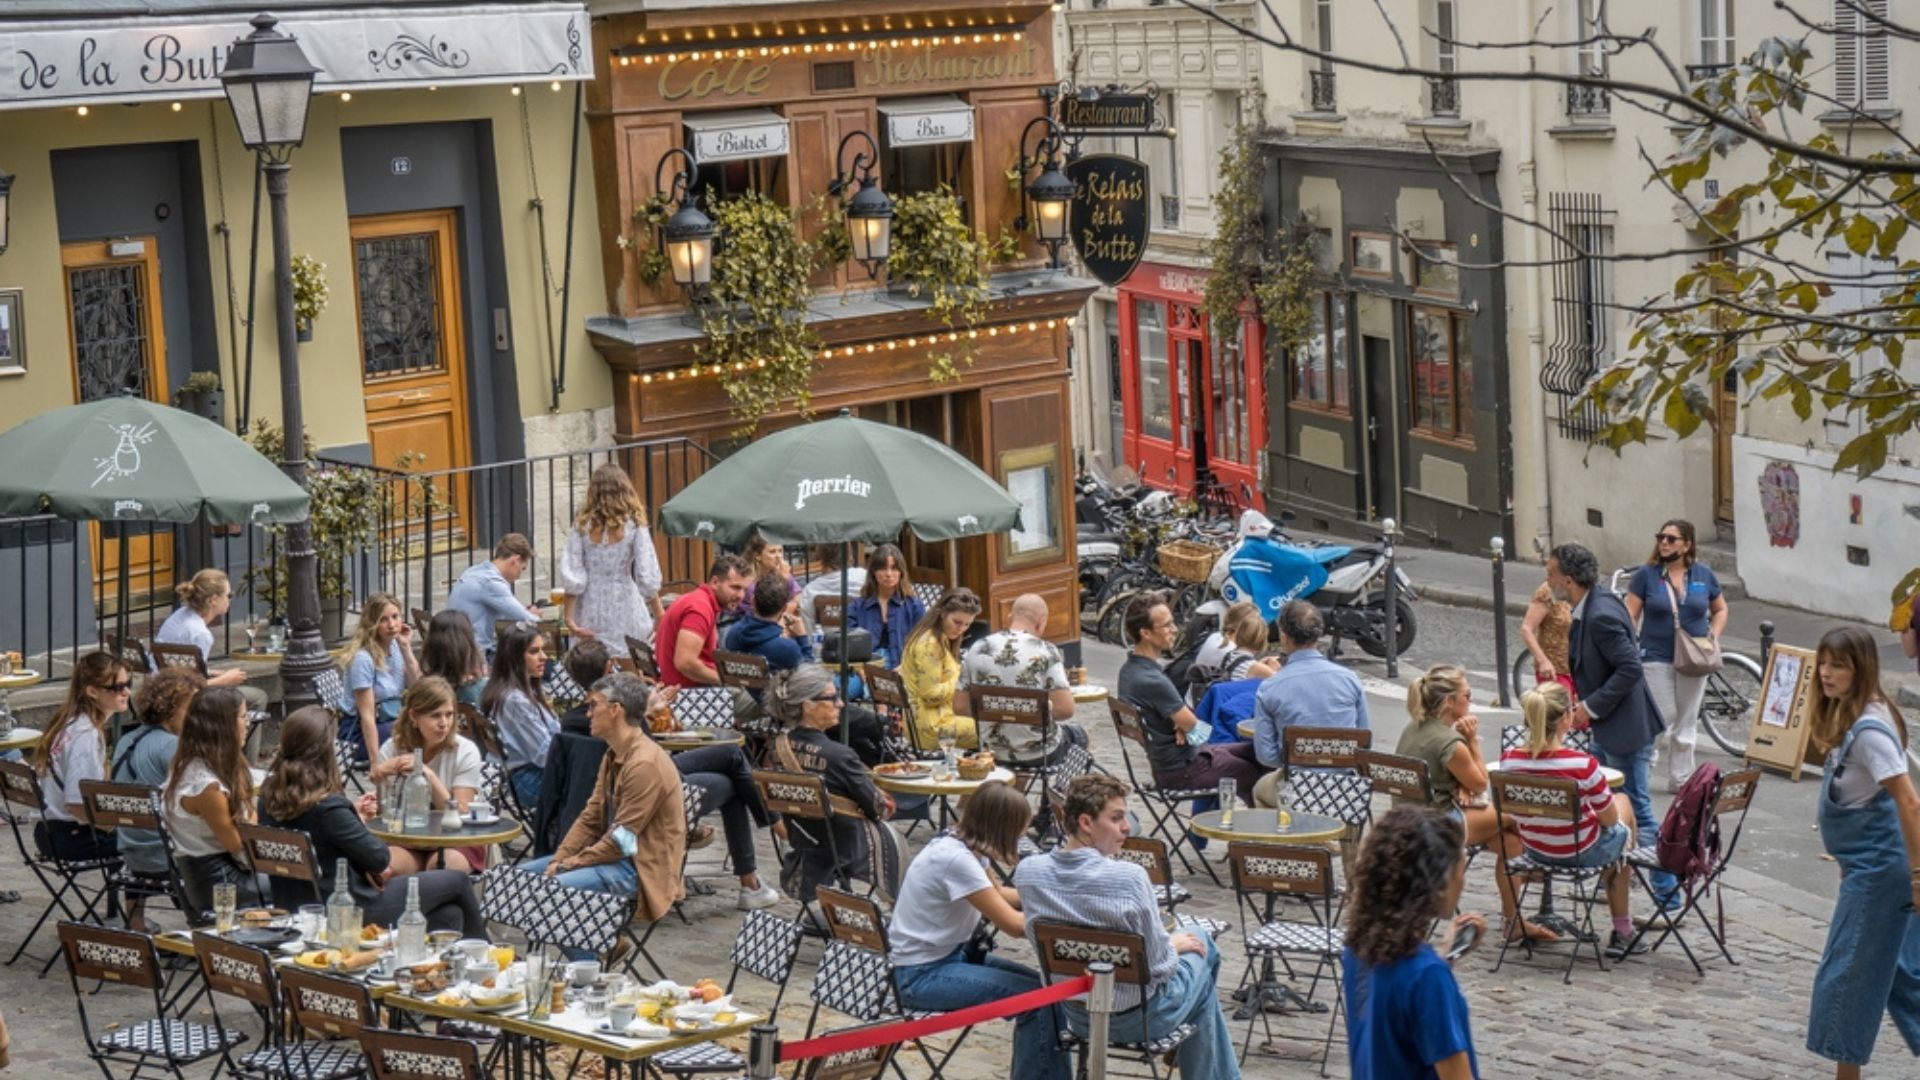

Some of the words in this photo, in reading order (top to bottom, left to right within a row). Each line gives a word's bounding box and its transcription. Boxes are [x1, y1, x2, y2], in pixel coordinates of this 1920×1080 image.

[16, 50, 59, 90] de
[78, 37, 119, 86] la
[862, 40, 1036, 86] Restaurant
[916, 117, 945, 136] Bar
[1066, 100, 1146, 125] Restaurant
[716, 131, 768, 153] Bistrot
[1086, 170, 1143, 204] Relais
[1091, 204, 1105, 229] de
[1108, 203, 1124, 227] la
[1083, 228, 1137, 262] Butte
[794, 474, 871, 511] perrier
[1792, 665, 1812, 728] EXPO
